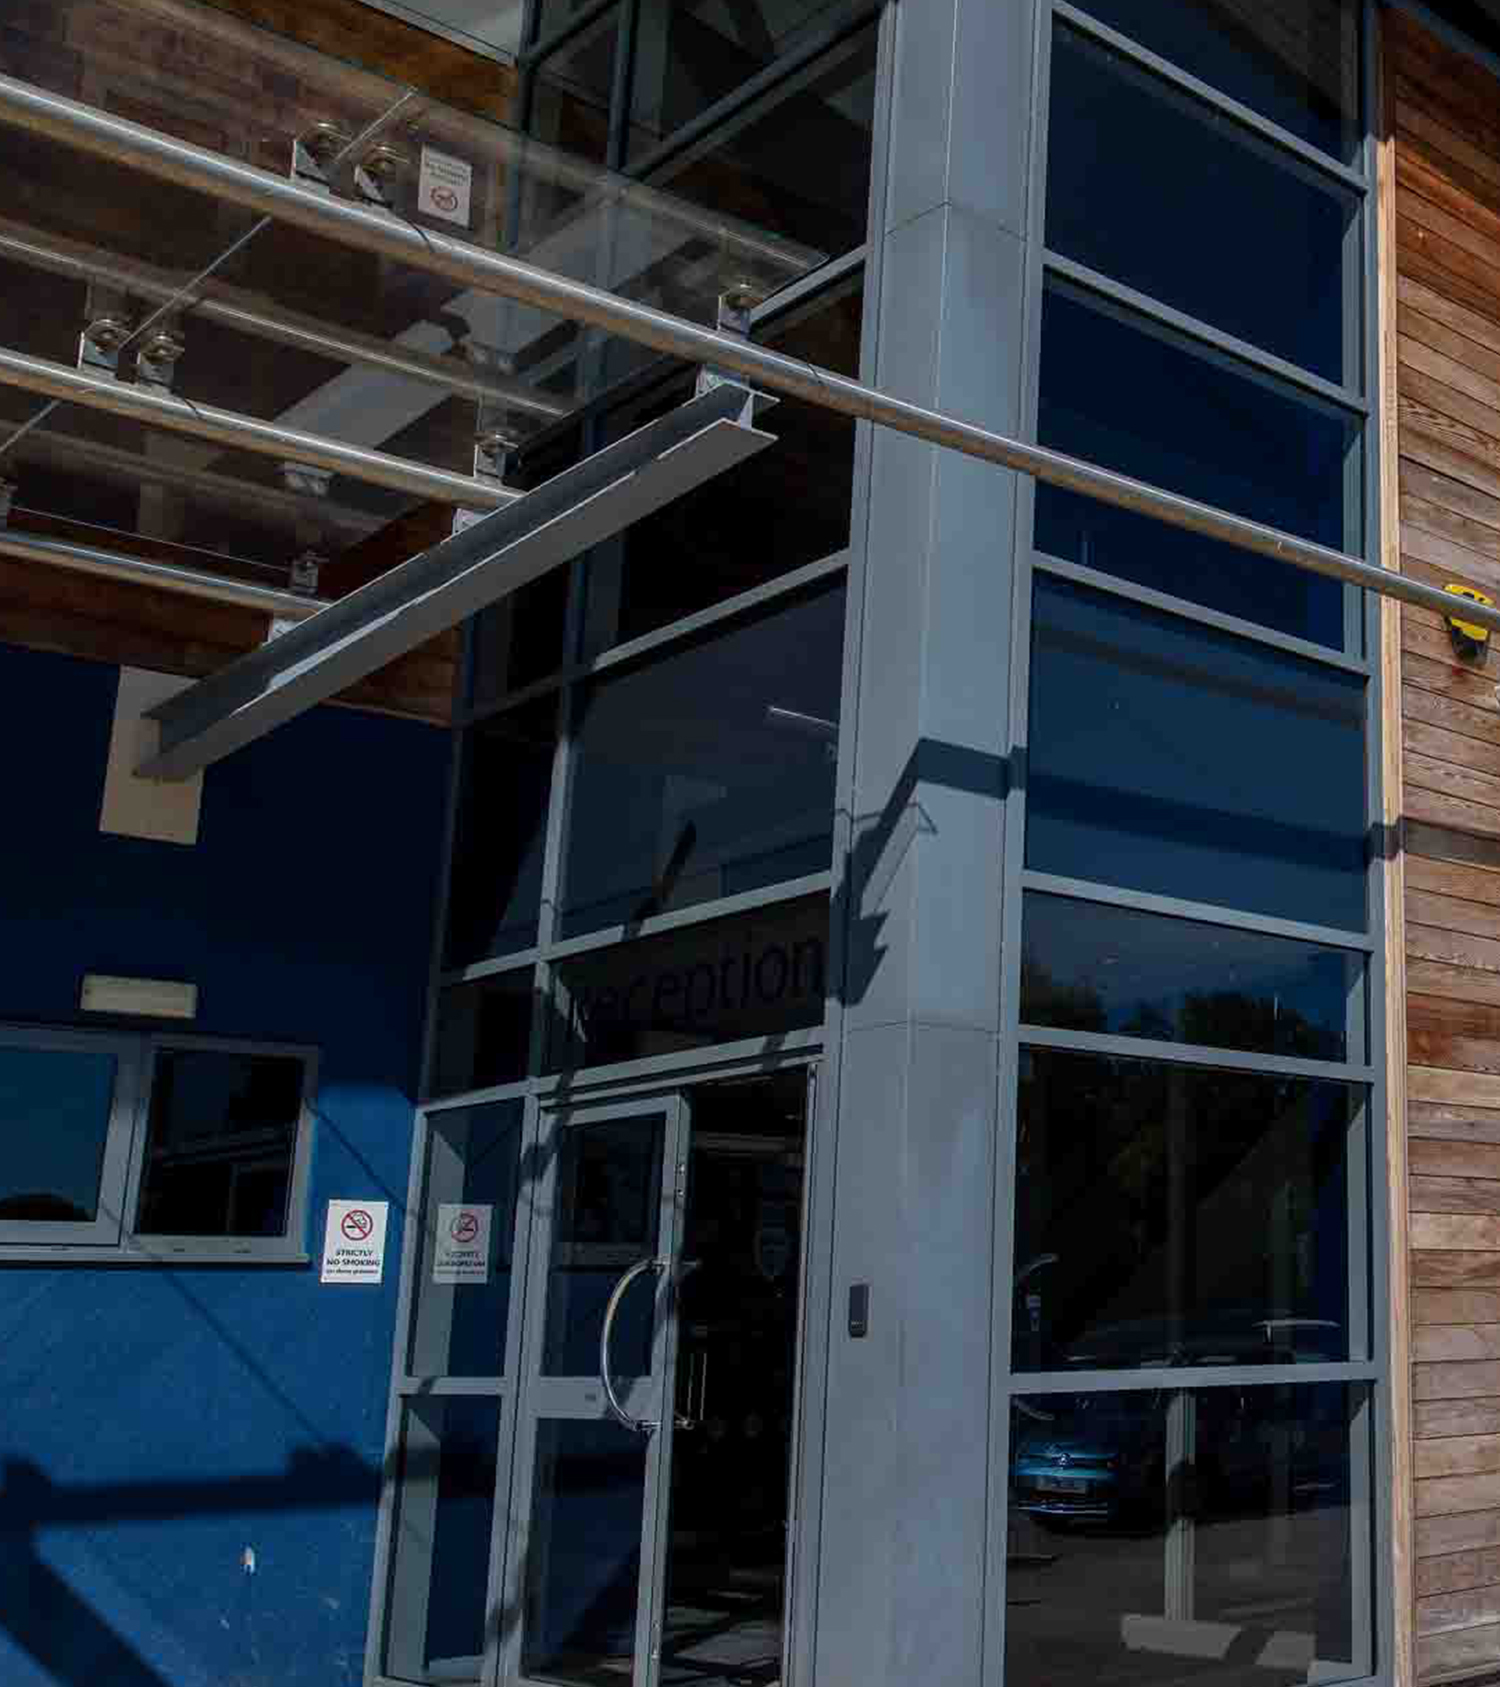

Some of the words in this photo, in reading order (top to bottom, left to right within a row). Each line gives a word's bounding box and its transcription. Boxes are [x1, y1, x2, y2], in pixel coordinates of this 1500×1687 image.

[336, 1249, 374, 1257] STRICTLY
[326, 1258, 340, 1266] NO
[342, 1258, 381, 1267] SMOKING
